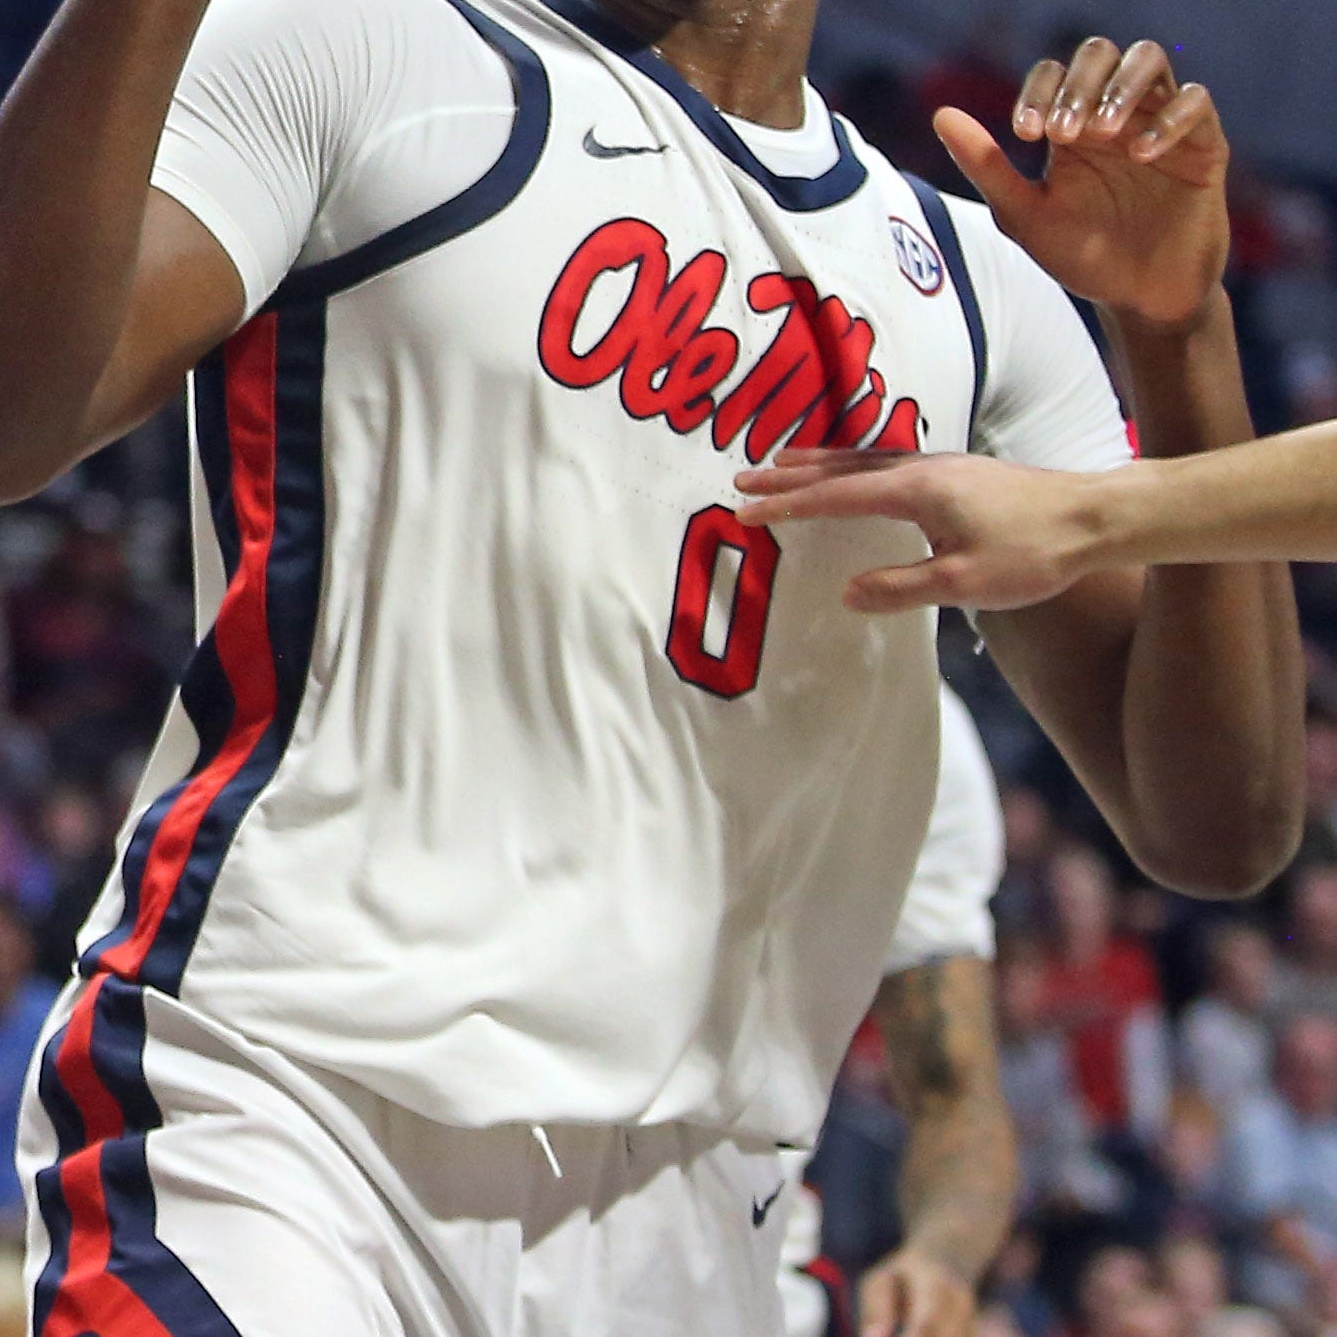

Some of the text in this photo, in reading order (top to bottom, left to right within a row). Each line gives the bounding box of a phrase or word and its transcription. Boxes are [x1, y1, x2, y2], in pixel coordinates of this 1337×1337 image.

[537, 216, 930, 466] Ole Mis
[665, 502, 782, 701] 0
